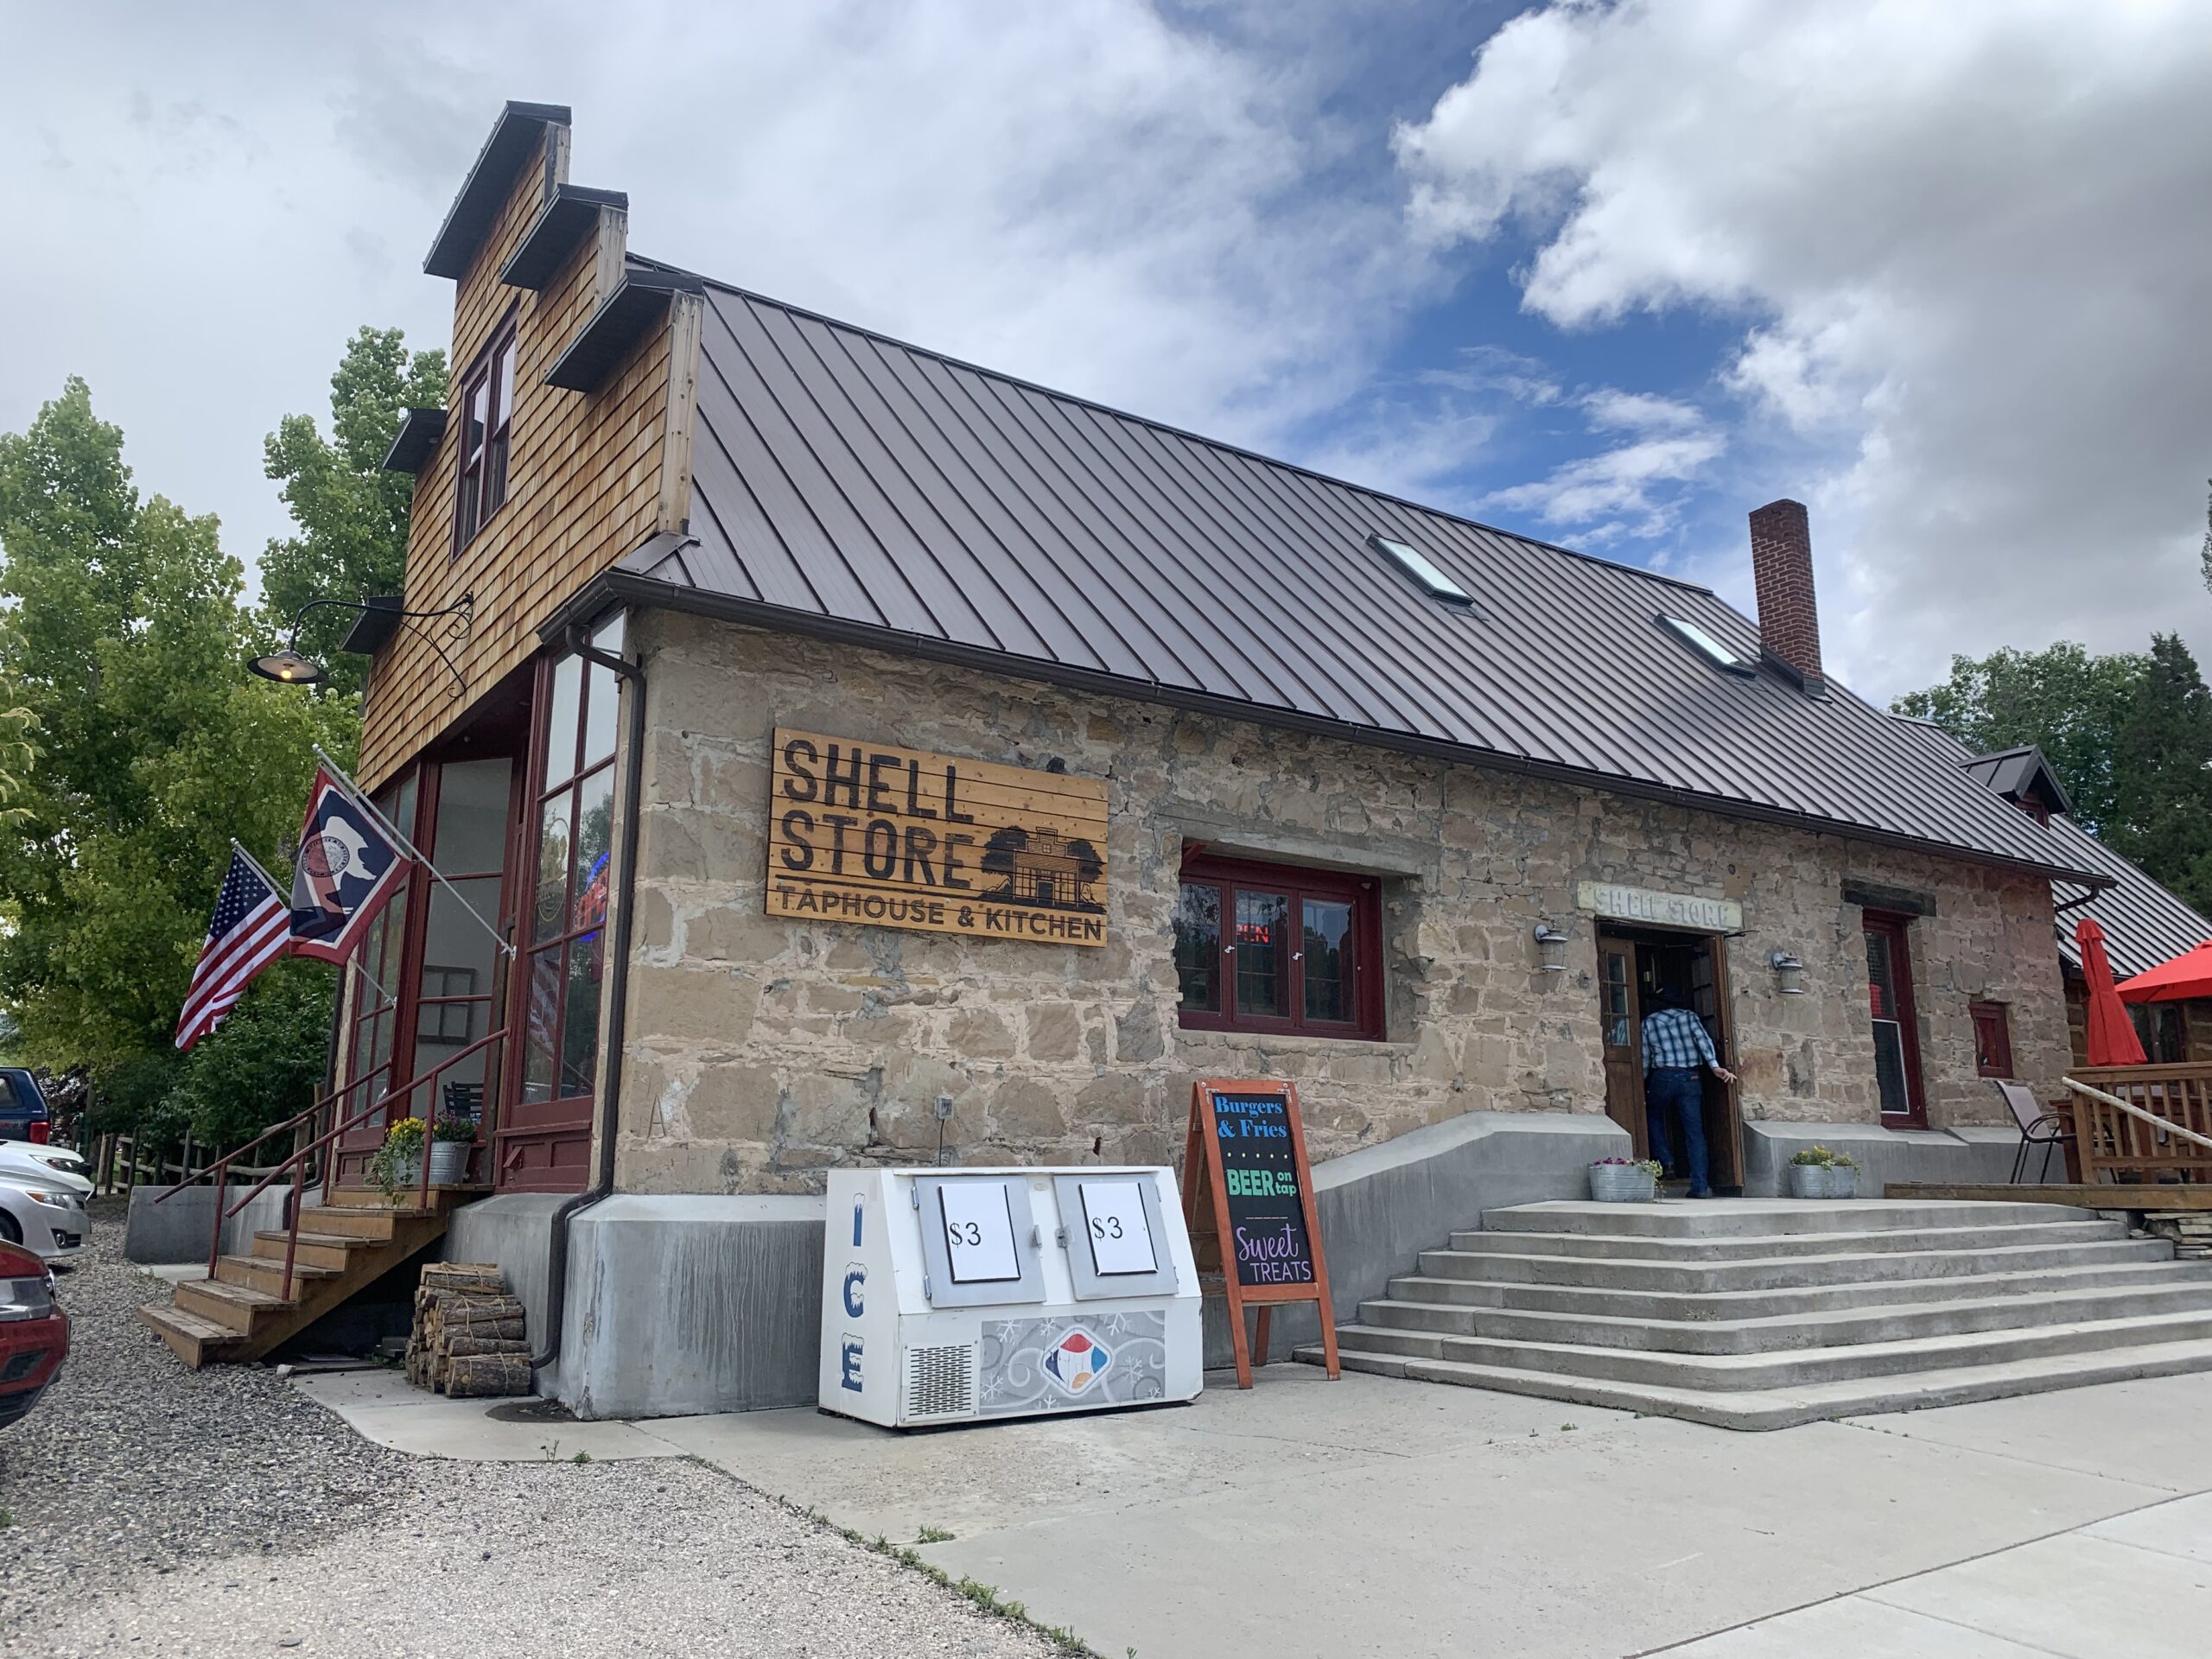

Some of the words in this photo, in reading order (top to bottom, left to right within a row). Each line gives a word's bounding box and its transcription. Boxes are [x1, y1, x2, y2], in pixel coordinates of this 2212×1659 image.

[783, 739, 975, 824] SHELL
[781, 810, 974, 889] STORE
[776, 885, 945, 925] TAPHOUSE
[957, 906, 976, 928] &
[985, 908, 1103, 942] KITCHEN
[1593, 888, 1659, 920] SHELL
[1668, 898, 1729, 929] STORE
[1215, 1096, 1283, 1118] Burgers
[1217, 1120, 1236, 1138] &
[1240, 1119, 1287, 1138] Fries
[1226, 1169, 1275, 1197] BEER
[1277, 1171, 1292, 1182] on
[1274, 1182, 1296, 1197] tap
[950, 1221, 982, 1249] $3
[1092, 1217, 1123, 1243] $3
[1236, 1224, 1299, 1261] Sweet
[1249, 1261, 1312, 1282] TREATS
[841, 1192, 868, 1393] ICE
